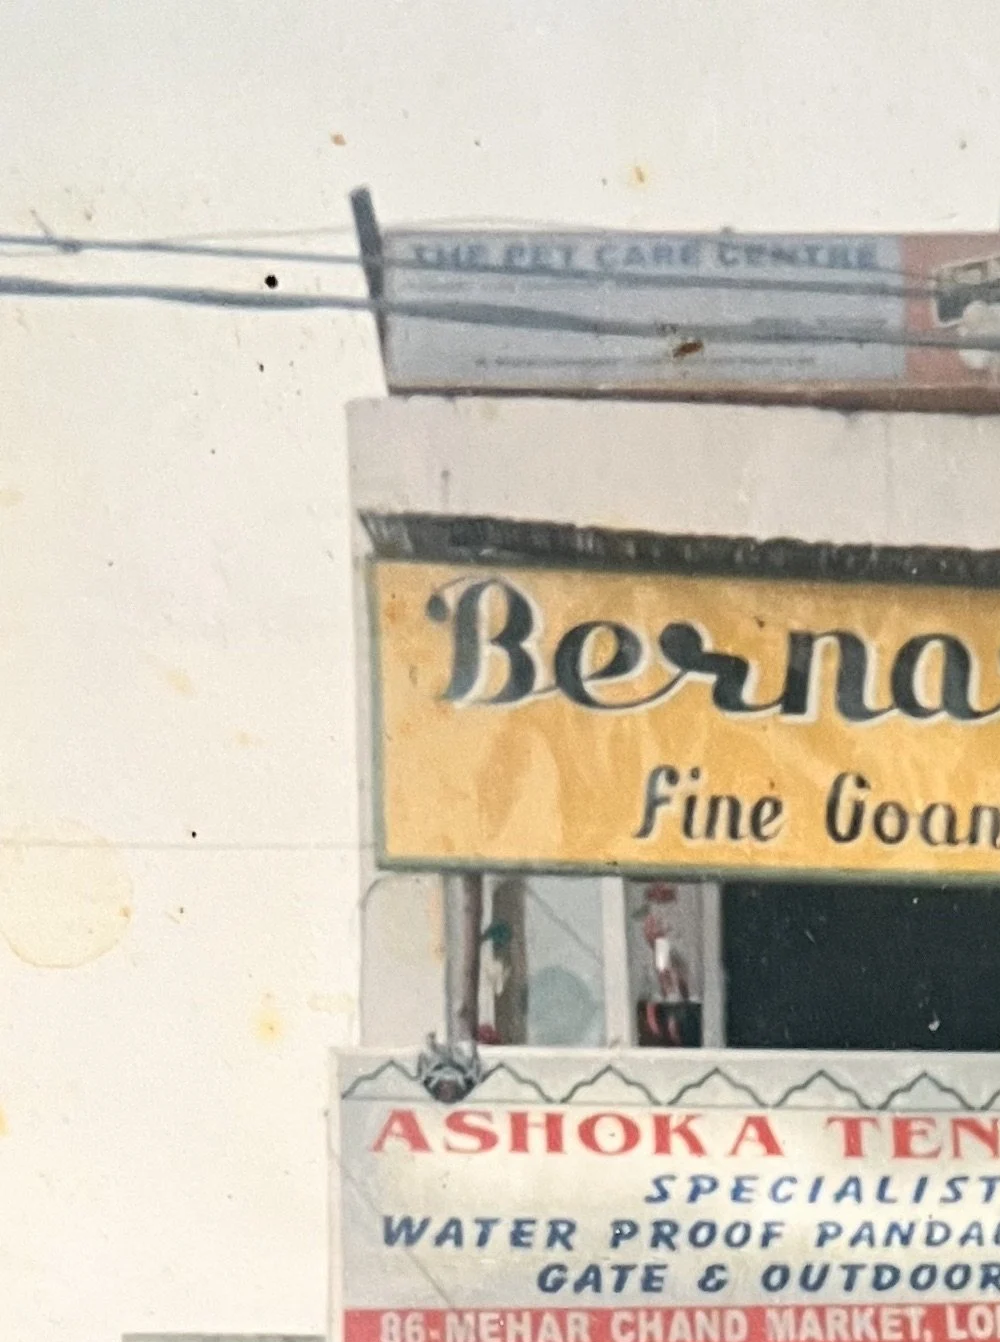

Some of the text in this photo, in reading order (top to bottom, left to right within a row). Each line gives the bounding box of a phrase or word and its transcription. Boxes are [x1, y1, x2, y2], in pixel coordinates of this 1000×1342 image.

[594, 245, 702, 268] CARE
[716, 243, 879, 270] CENTRE
[372, 1108, 784, 1158] ASHOKA
[382, 1214, 577, 1250] WATER
[608, 1219, 785, 1250] PROOF
[537, 1263, 668, 1295] GATE
[697, 1263, 729, 1294] &
